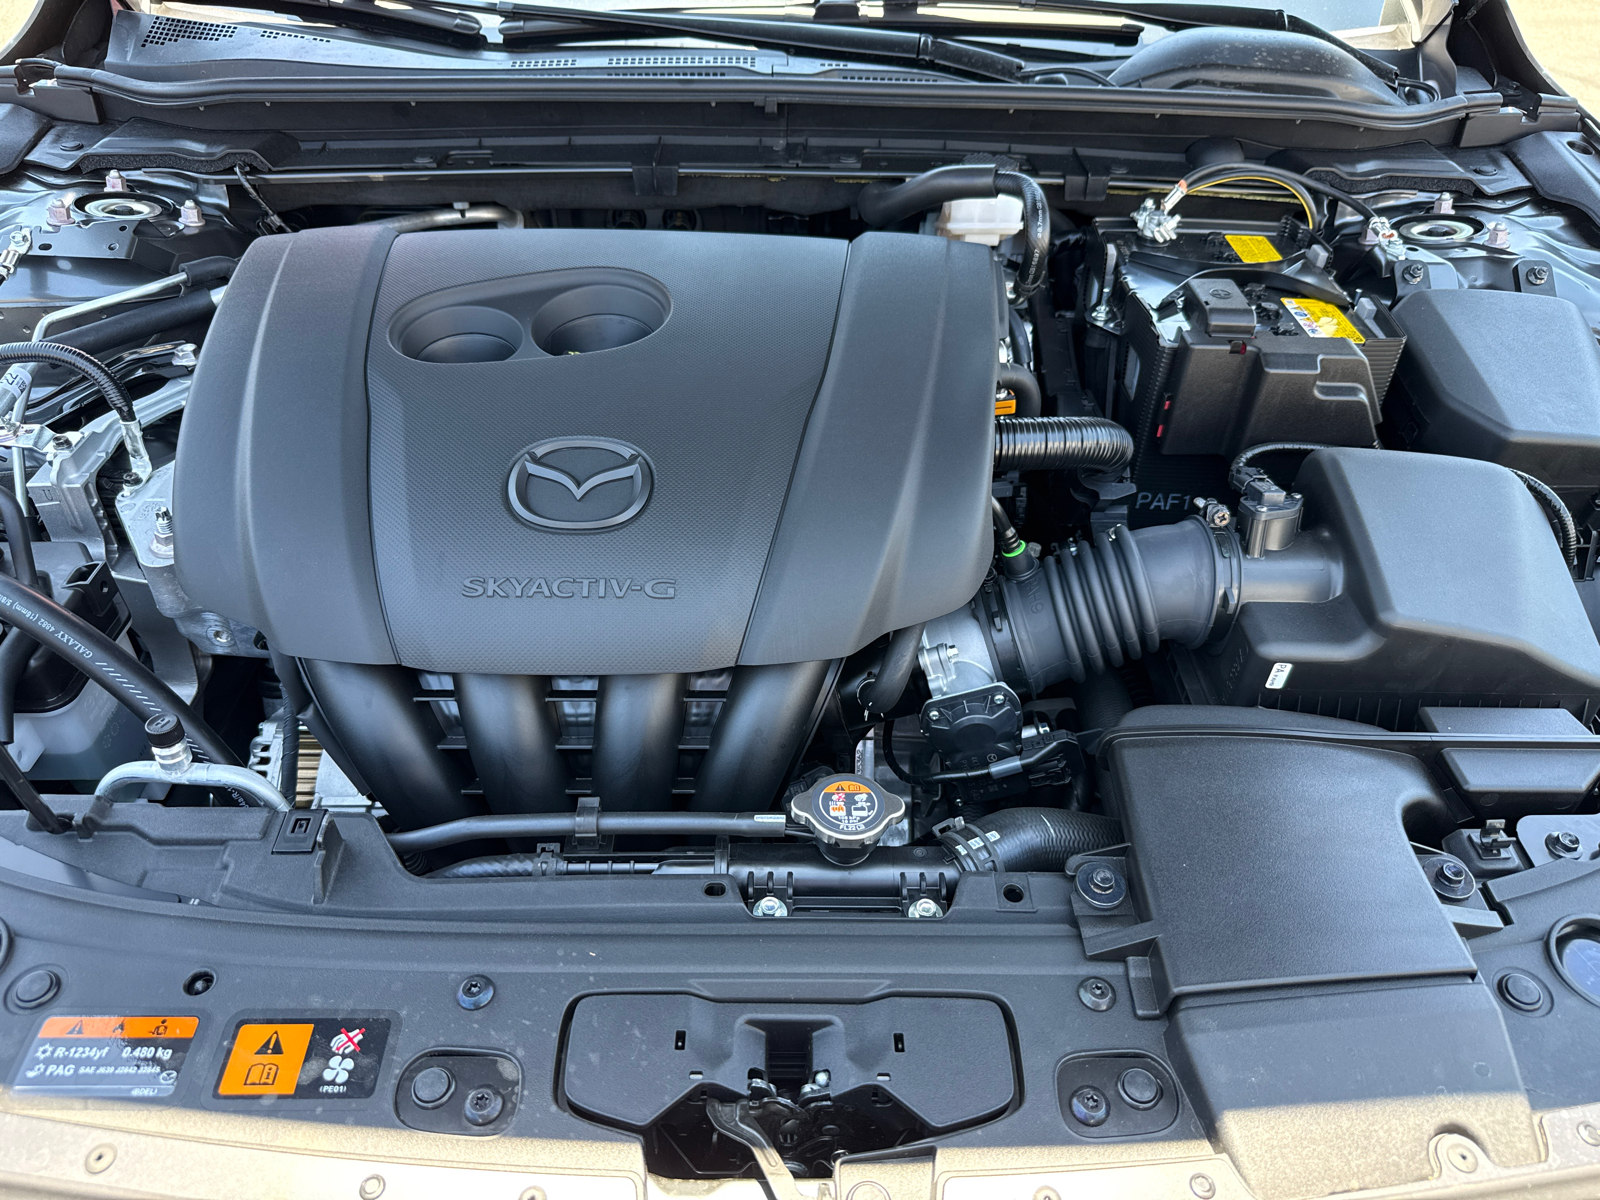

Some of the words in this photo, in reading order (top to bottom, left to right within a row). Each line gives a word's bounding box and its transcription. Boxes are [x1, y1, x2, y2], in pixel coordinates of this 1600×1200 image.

[1135, 492, 1191, 511] PAF1
[461, 577, 677, 600] SKYACTIV-G
[54, 630, 94, 659] GALAXY
[53, 1046, 110, 1061] R-1234yf
[121, 1046, 156, 1059] 0.480
[156, 1046, 173, 1060] kg
[45, 1064, 75, 1077] PAG
[78, 1066, 97, 1075] SAE
[95, 1066, 115, 1074] J639
